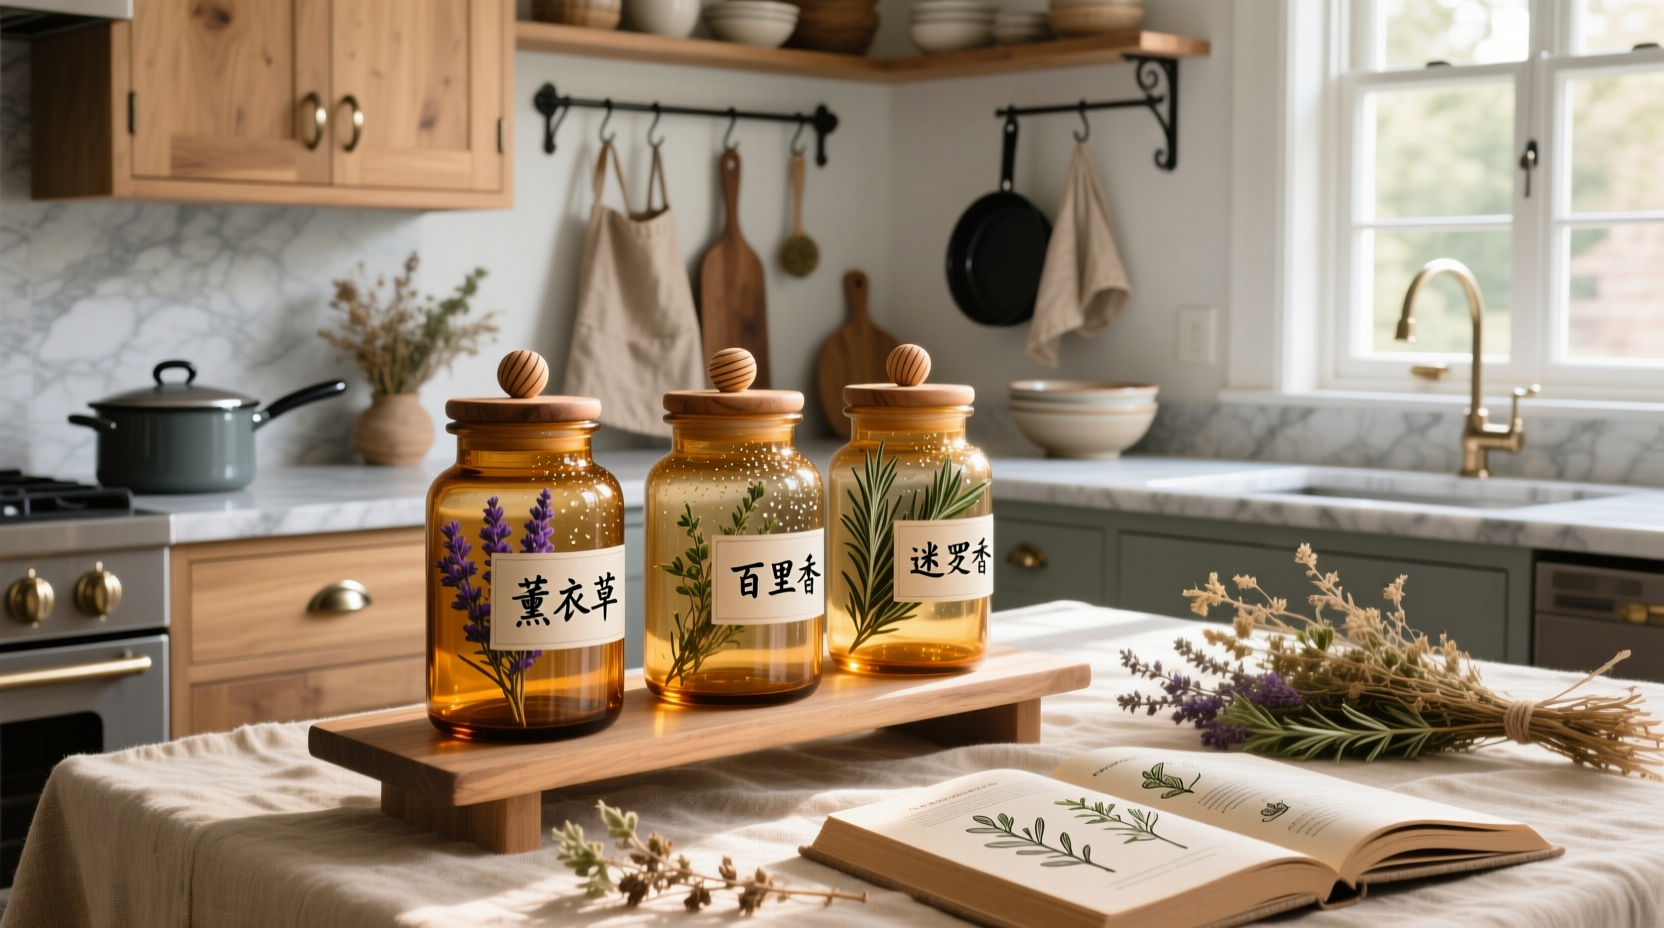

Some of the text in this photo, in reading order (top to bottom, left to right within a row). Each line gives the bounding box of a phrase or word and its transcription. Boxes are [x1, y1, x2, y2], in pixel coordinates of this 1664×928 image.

[511, 571, 618, 628] 薰衣草
[730, 553, 822, 599] 百里香
